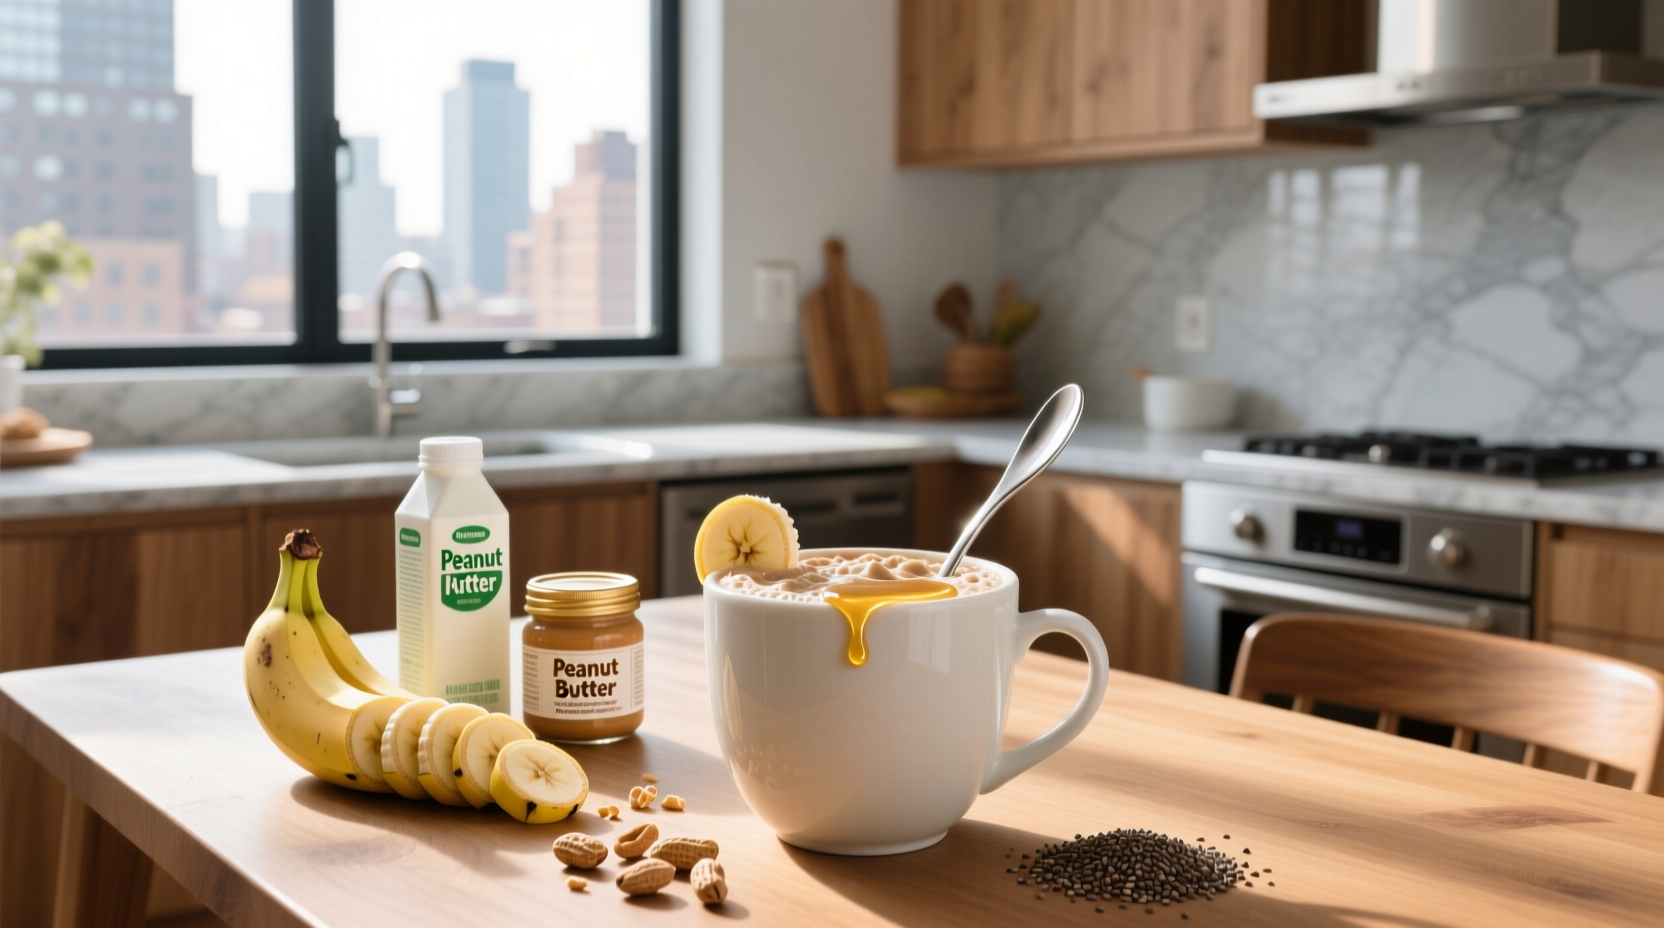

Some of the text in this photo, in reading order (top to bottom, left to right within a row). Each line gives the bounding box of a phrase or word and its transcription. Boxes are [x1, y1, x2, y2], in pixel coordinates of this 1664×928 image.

[441, 548, 503, 571] Peanut
[553, 658, 619, 677] Peanut
[555, 679, 617, 698] Butter
